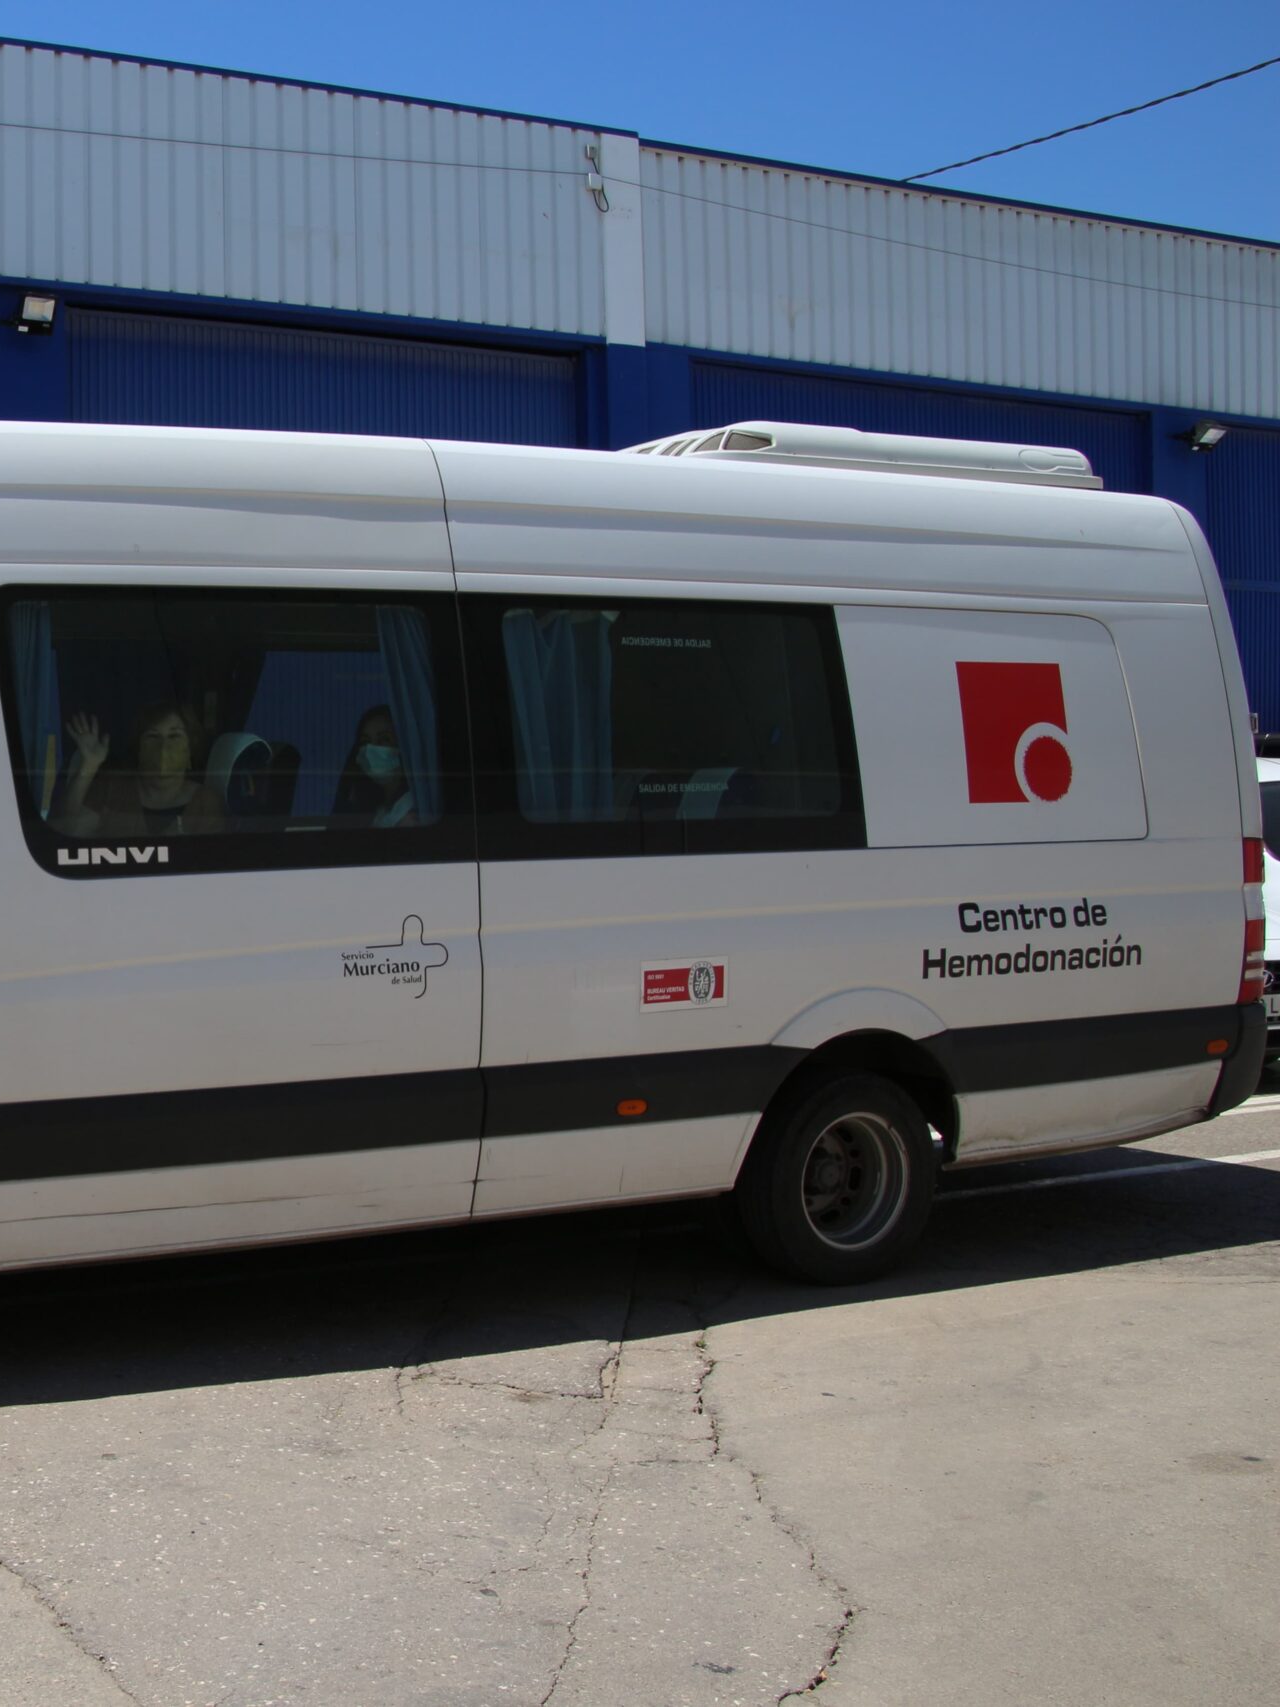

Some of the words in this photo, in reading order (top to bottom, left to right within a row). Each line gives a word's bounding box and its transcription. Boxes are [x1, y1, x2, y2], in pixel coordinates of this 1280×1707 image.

[639, 783, 666, 793] SALIDA
[668, 783, 679, 793] DE
[57, 846, 169, 865] UNVI
[958, 901, 1067, 933] Centro
[1073, 897, 1108, 928] de
[341, 951, 375, 961] Servicio
[922, 934, 1143, 979] Hemodonación
[343, 958, 421, 978] Murciano
[391, 976, 400, 985] de
[402, 974, 423, 984] Salud
